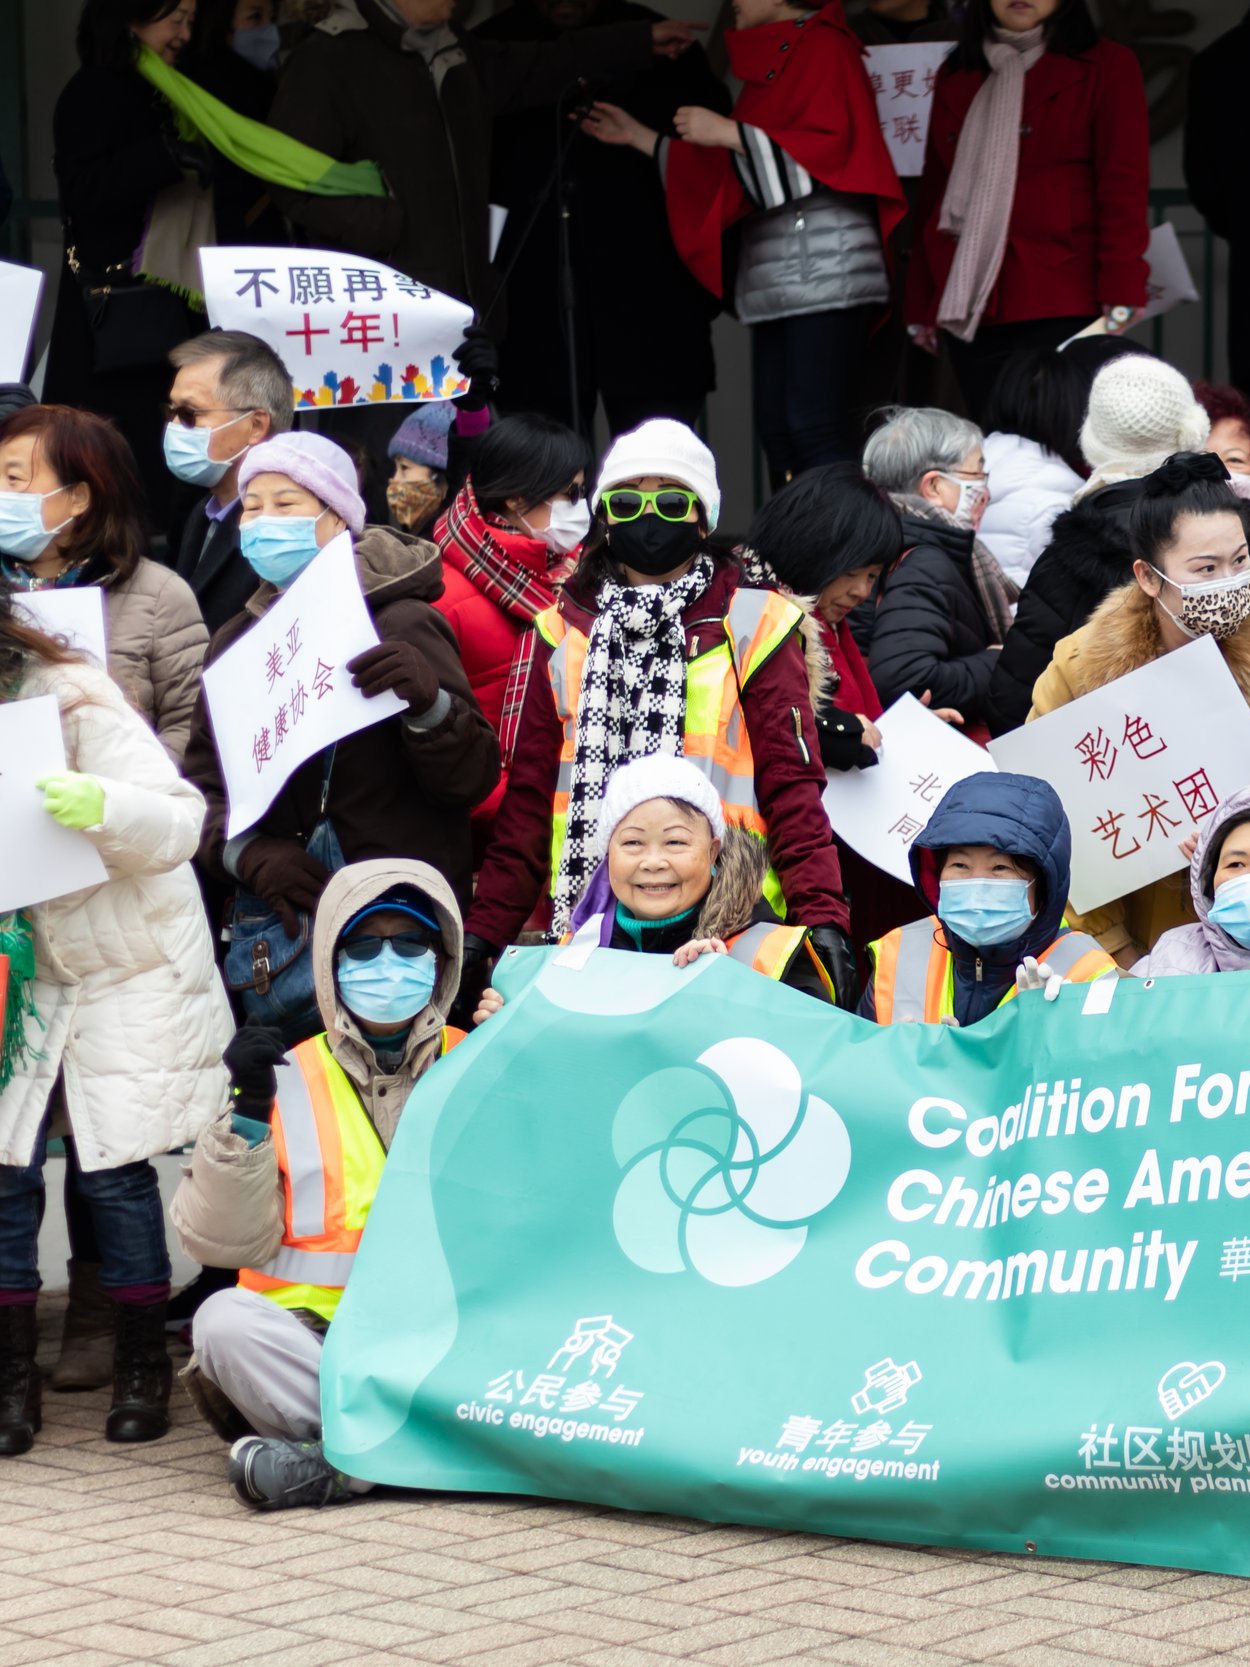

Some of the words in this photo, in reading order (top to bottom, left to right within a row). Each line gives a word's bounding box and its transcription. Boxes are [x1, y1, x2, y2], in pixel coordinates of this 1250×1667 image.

[880, 113, 923, 145] 联
[285, 310, 400, 356] 十年!
[252, 657, 335, 775] 健康协会
[1073, 713, 1168, 784] 彩色
[1090, 766, 1219, 861] 艺术团
[907, 1077, 1152, 1158] Coalition
[886, 1167, 1110, 1230] Chinese
[854, 1228, 1199, 1302] Community
[484, 1368, 646, 1422] 公民参与
[456, 1400, 505, 1426] civic
[509, 1410, 645, 1447] engagement
[775, 1414, 935, 1456] 青年参与
[735, 1446, 801, 1472] youth
[801, 1455, 941, 1481] engagement
[1044, 1472, 1182, 1494] community
